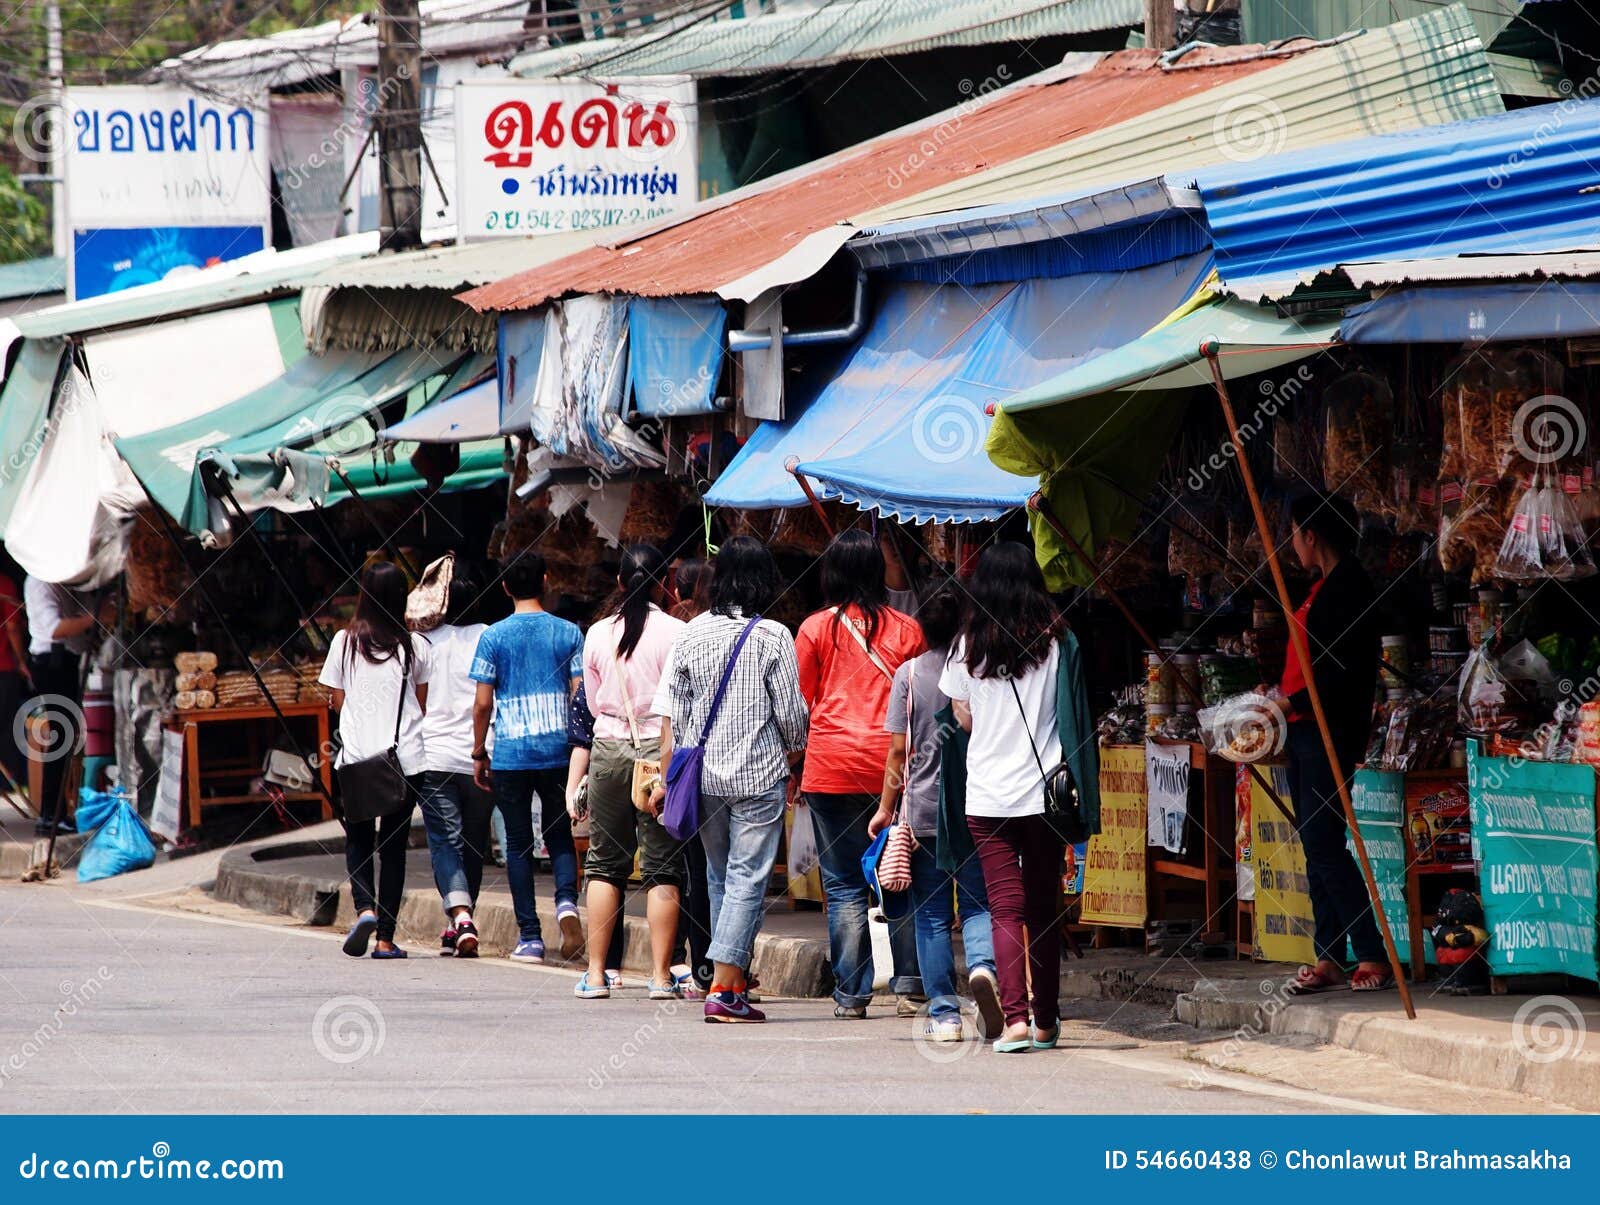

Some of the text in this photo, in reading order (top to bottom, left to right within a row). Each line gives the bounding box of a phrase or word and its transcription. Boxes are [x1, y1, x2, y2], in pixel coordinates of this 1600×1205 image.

[74, 98, 255, 152] ของฝาก
[483, 85, 676, 168] ดูเด่น
[531, 164, 677, 202] น้ำพริกหนุ่ม
[1491, 864, 1544, 908] แคบหมู
[1495, 920, 1549, 963] หมูกระจก
